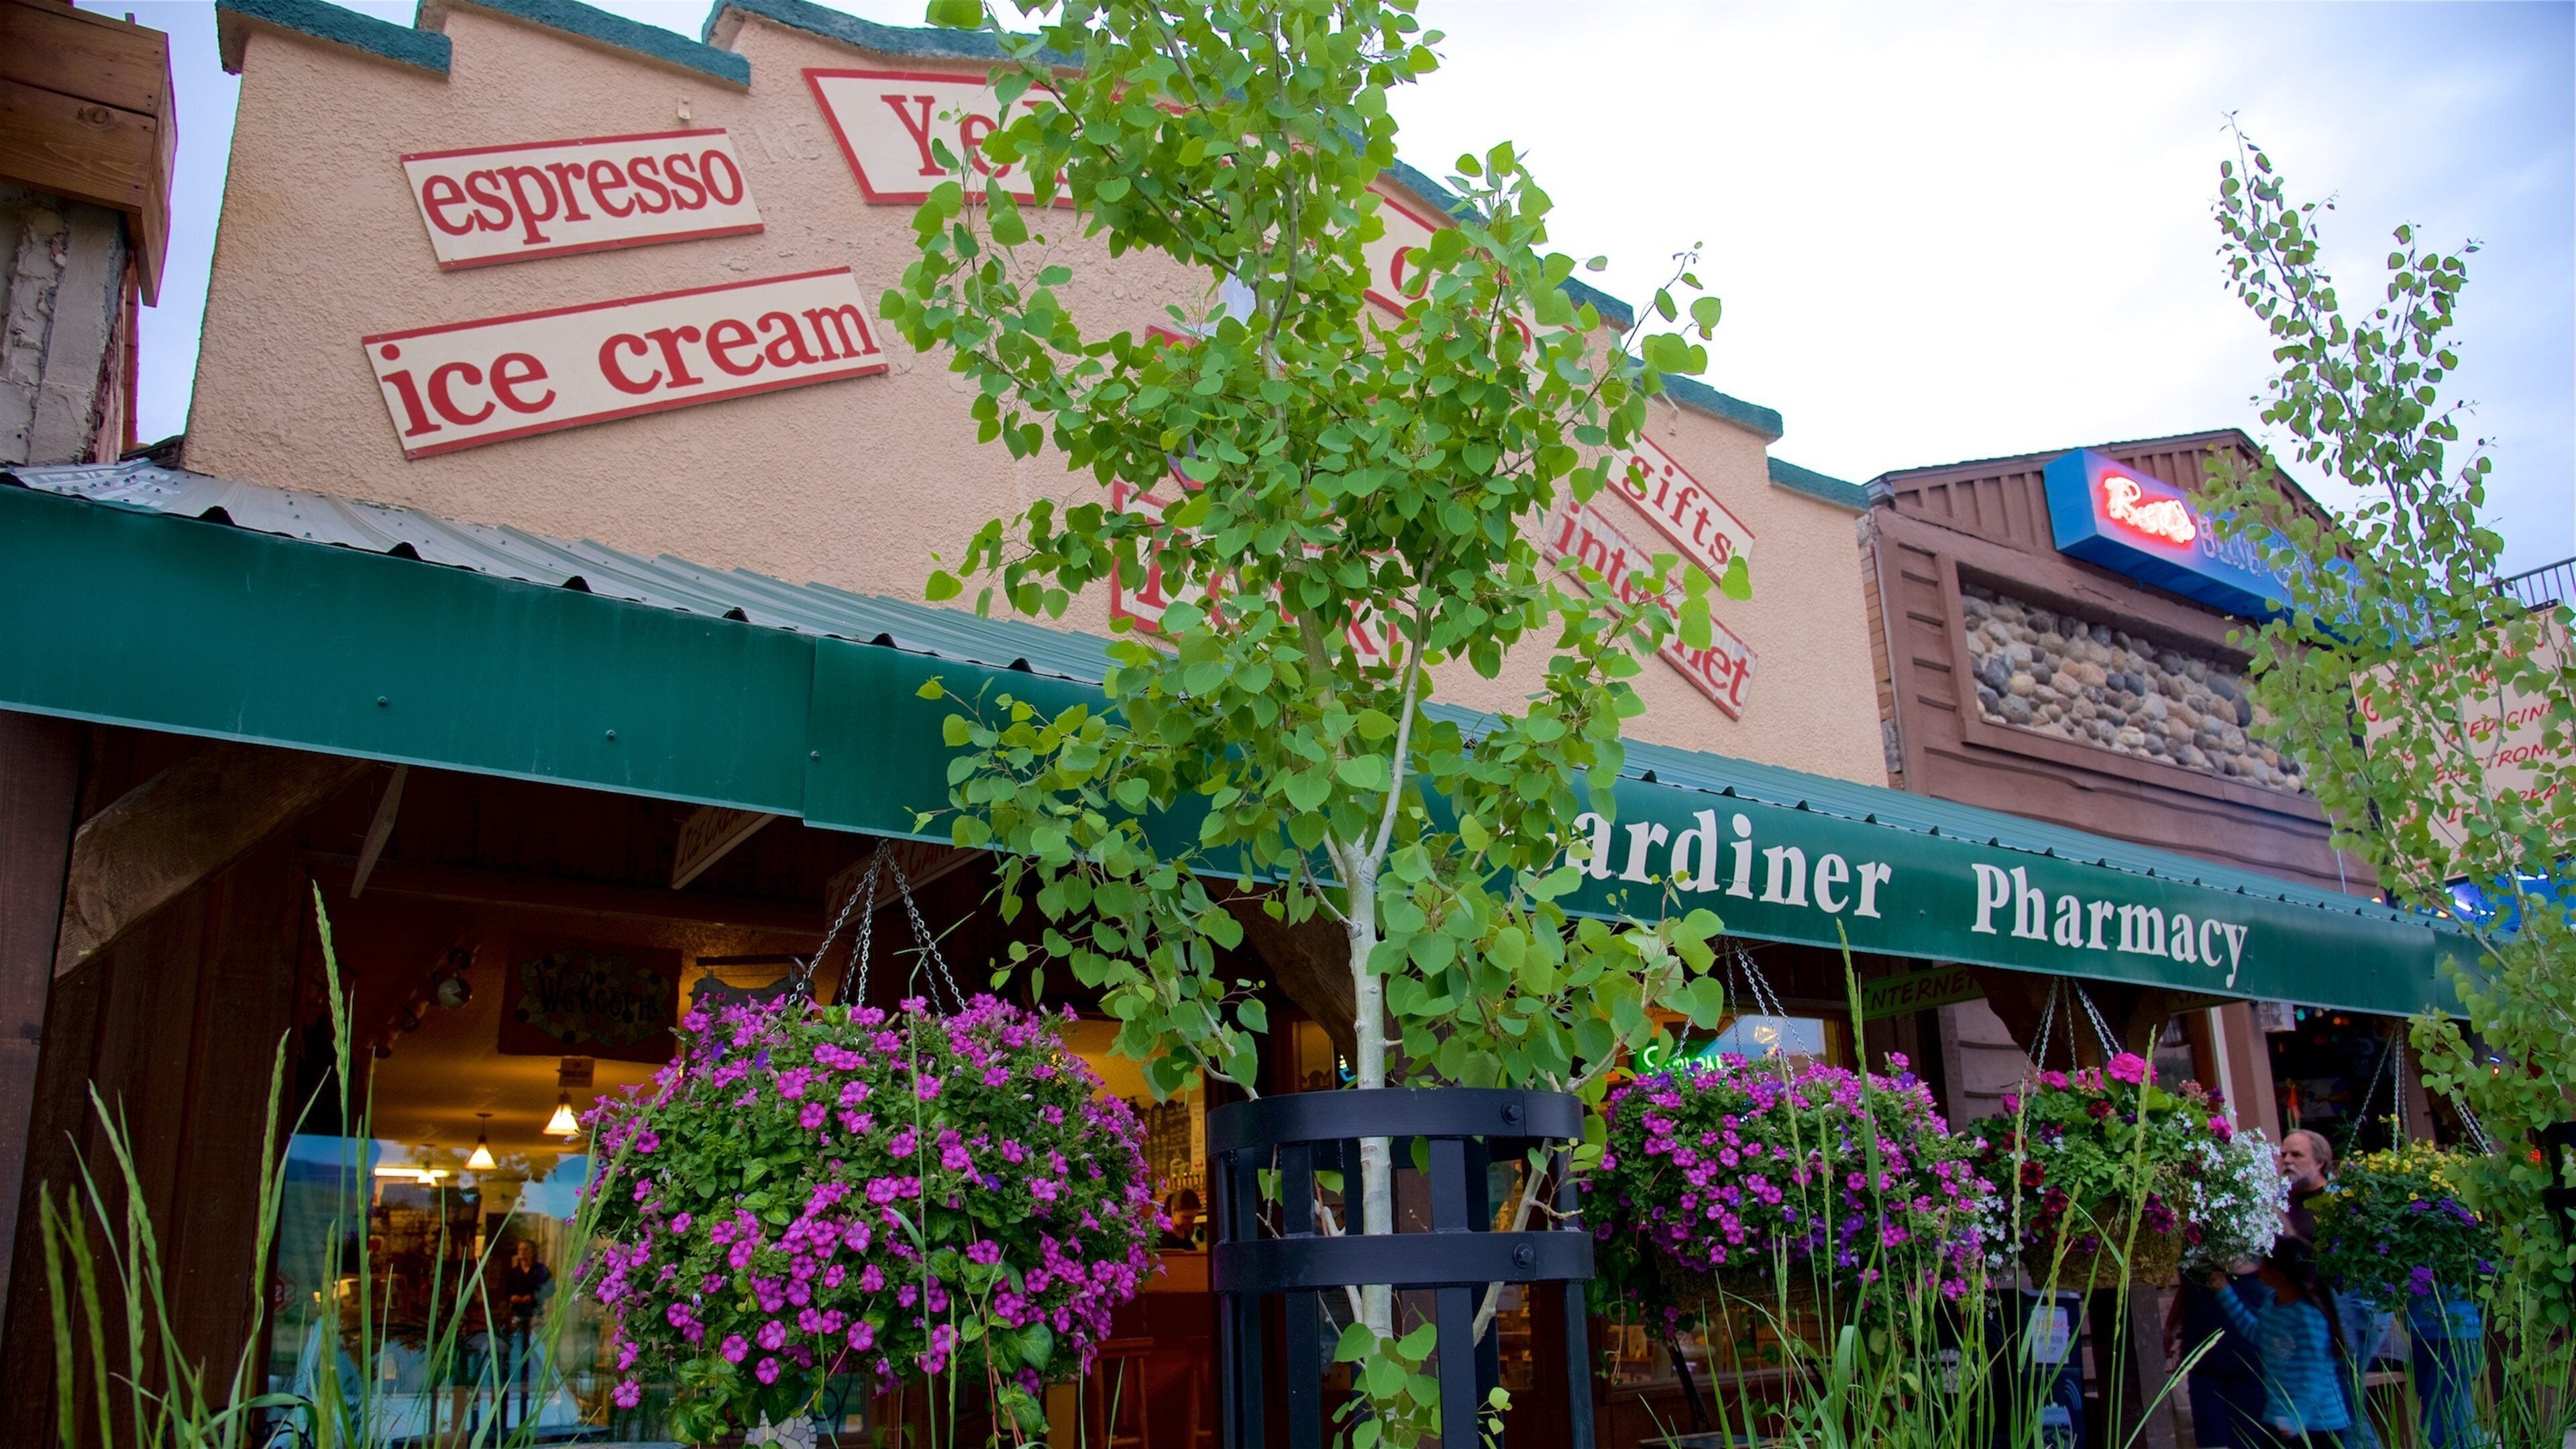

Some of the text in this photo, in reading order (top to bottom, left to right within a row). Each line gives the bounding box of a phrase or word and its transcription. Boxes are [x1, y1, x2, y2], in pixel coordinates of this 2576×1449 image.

[422, 149, 743, 245] espresso
[381, 303, 880, 437] ice cream
[1622, 455, 1731, 564] gifts
[2444, 702, 2555, 745] EDCIN
[705, 808, 746, 847] CREA
[1525, 808, 2248, 989] ardiner Pharmacy
